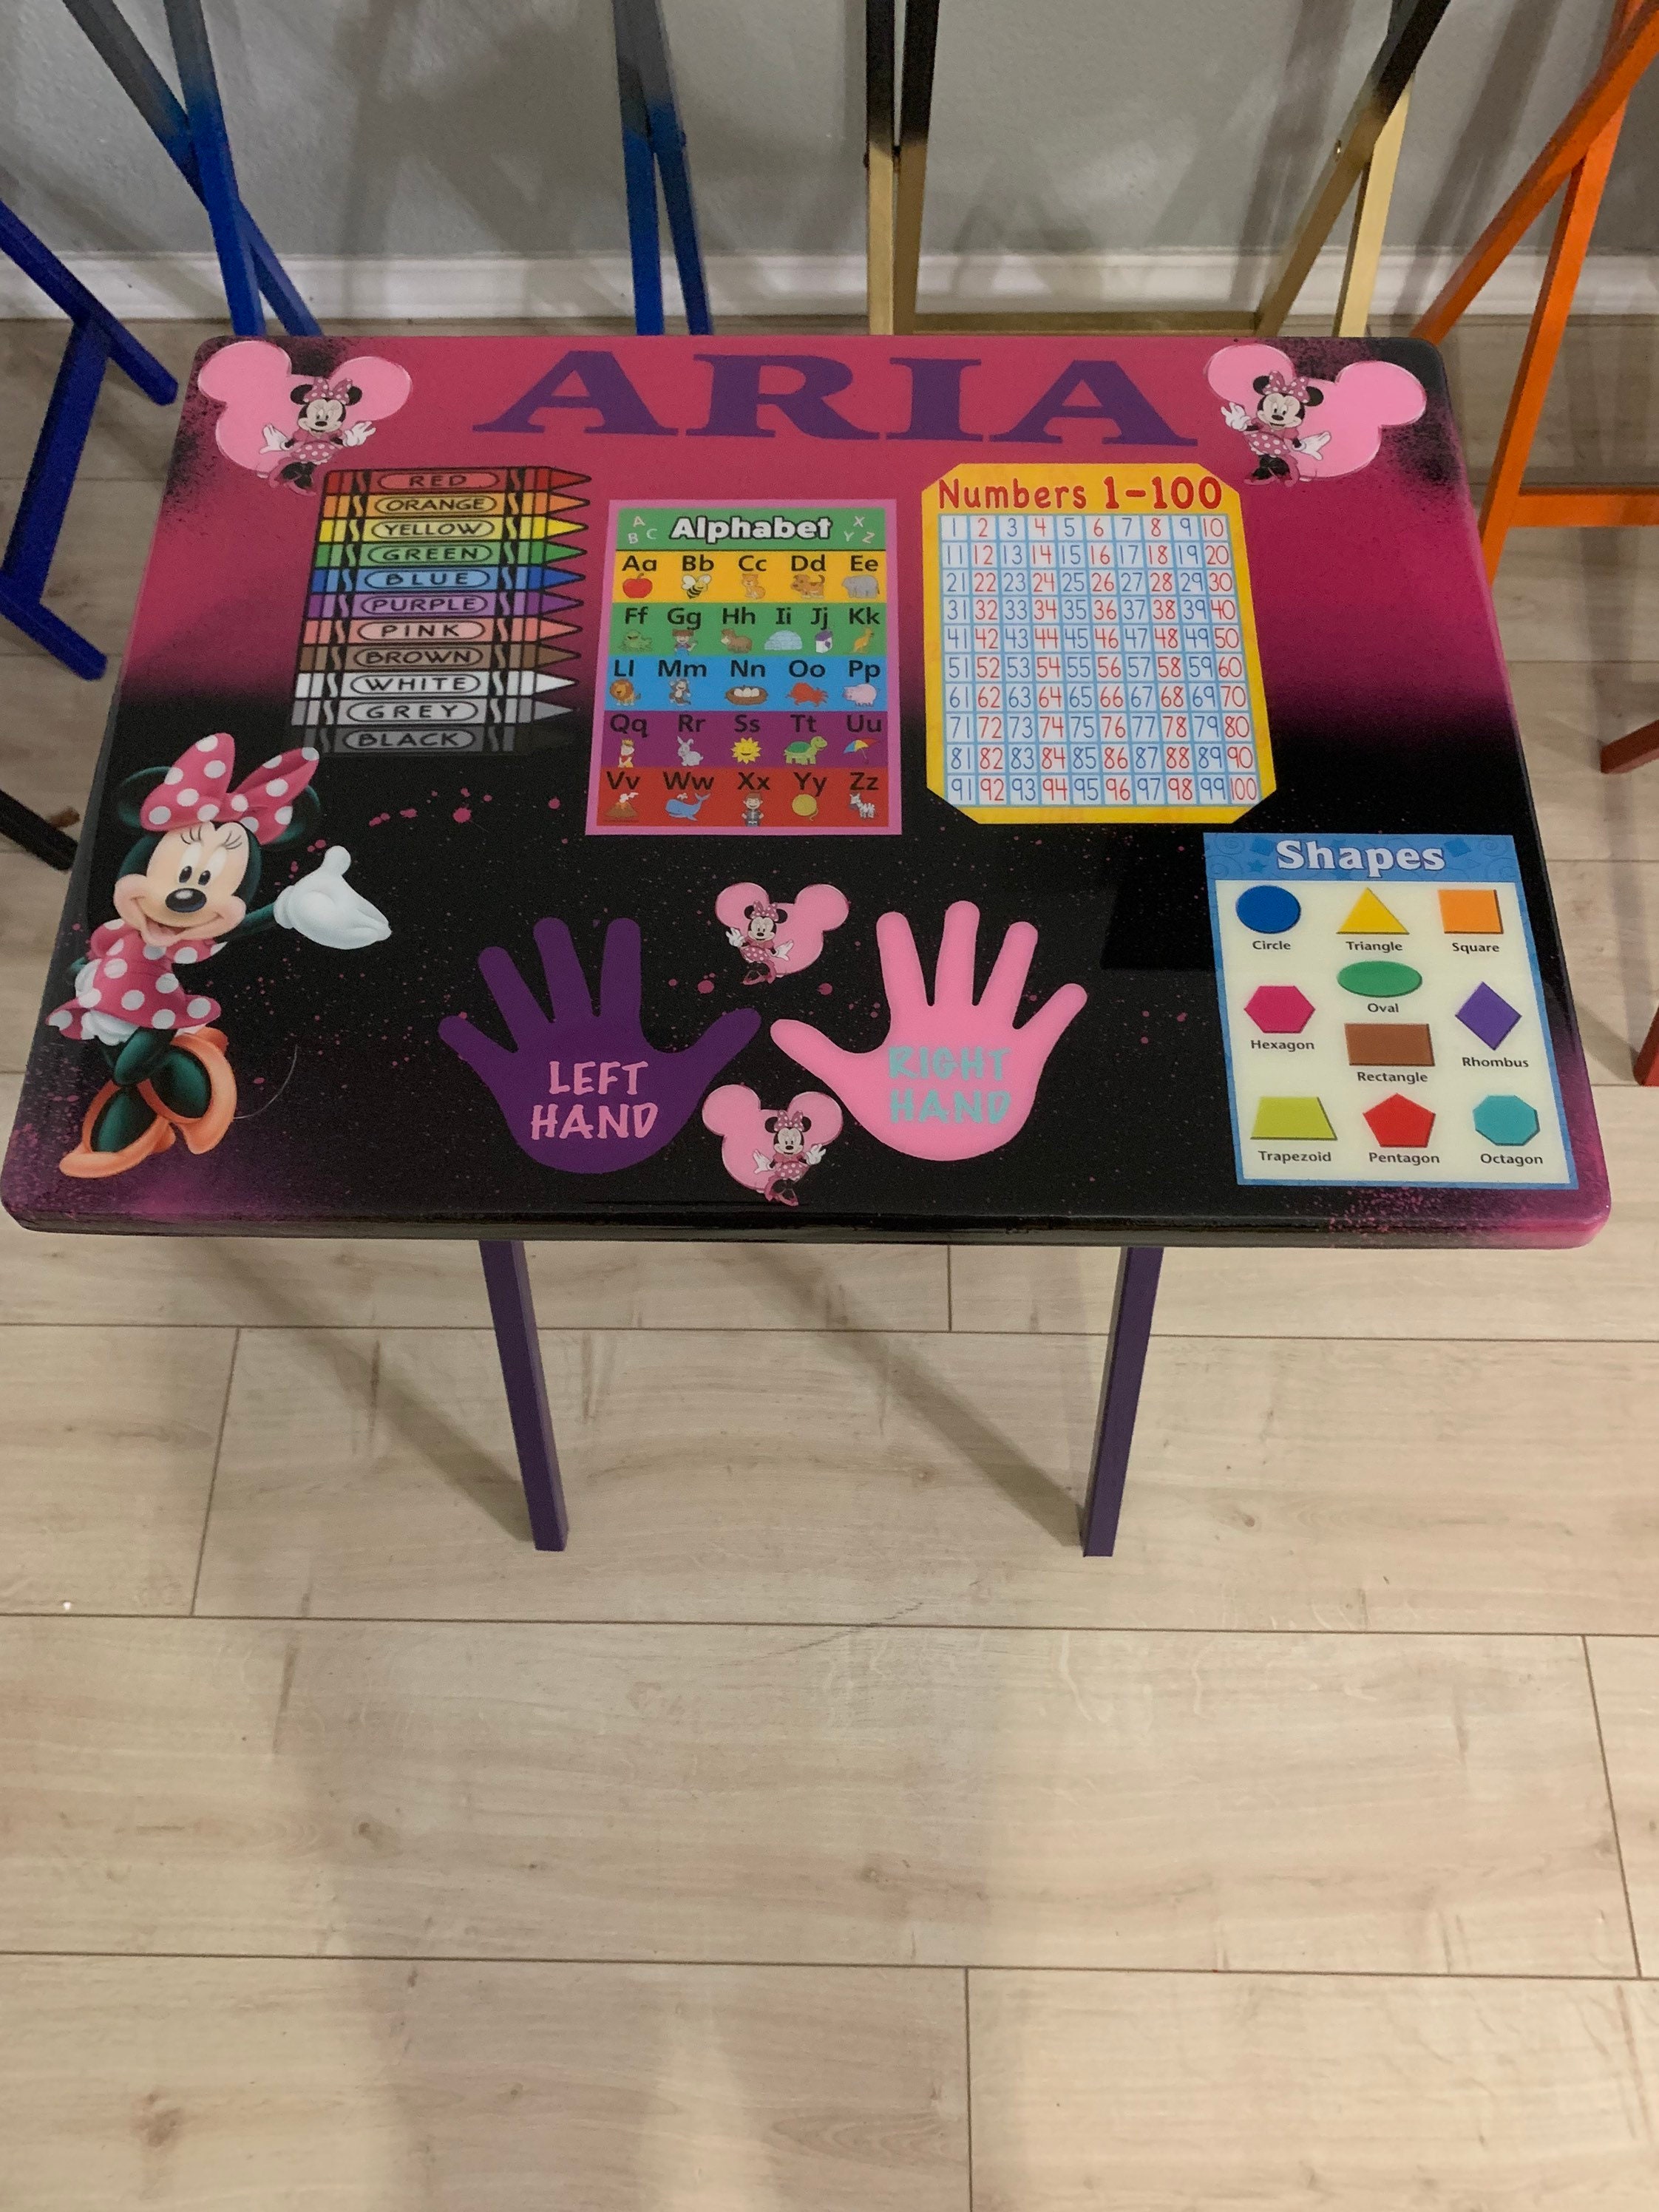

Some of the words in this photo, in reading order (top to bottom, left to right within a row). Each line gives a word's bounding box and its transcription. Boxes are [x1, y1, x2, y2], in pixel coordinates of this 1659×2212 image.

[472, 349, 1198, 447] ARIA
[409, 475, 467, 486] RED
[938, 478, 1087, 510] Numbers
[1104, 475, 1222, 510] 1-100
[386, 498, 484, 512] ORANGE
[385, 523, 481, 537] YELLOW
[669, 515, 832, 545] Alphabet
[1034, 517, 1046, 537] 4
[1093, 517, 1104, 537] 6
[1150, 517, 1161, 537] 8
[1202, 517, 1224, 537] 10
[383, 547, 478, 560] GREEN
[622, 554, 657, 571] Aa
[682, 554, 714, 571] Bb
[738, 554, 767, 571] Cc
[790, 554, 827, 572] Dd
[850, 554, 879, 572] Ee
[947, 545, 963, 565] 11
[974, 544, 993, 565] 12
[1003, 544, 1022, 565] 13
[1032, 544, 1052, 564] 14
[1062, 544, 1081, 565] 15
[1090, 545, 1110, 565] 16
[1119, 544, 1139, 564] 17
[1148, 544, 1168, 565] 18
[1178, 544, 1198, 564] 19
[1204, 544, 1229, 565] 20
[386, 572, 469, 586] BLUE
[946, 572, 966, 592] 21
[974, 571, 997, 592] 22
[1003, 572, 1026, 592] 23
[1032, 572, 1055, 593] 24
[1062, 571, 1085, 592] 25
[1091, 572, 1115, 592] 26
[1120, 571, 1143, 592] 27
[1149, 571, 1173, 592] 28
[1181, 571, 1204, 592] 29
[1209, 571, 1233, 592] 30
[371, 597, 476, 611] PURPLE
[947, 599, 966, 620] 31
[974, 599, 998, 620] 32
[1005, 599, 1028, 620] 33
[1034, 599, 1057, 620] 34
[1063, 598, 1087, 620] 35
[1093, 599, 1117, 620] 36
[1123, 598, 1146, 620] 37
[1153, 599, 1175, 620] 38
[1183, 598, 1207, 620] 39
[1210, 599, 1236, 620] 40
[624, 606, 648, 625] Ff
[667, 607, 702, 630] Gg
[722, 606, 756, 625] Hh
[776, 607, 793, 625] Ii
[810, 607, 829, 629] Jj
[849, 606, 880, 625] Kk
[381, 624, 459, 637] PINK
[947, 628, 967, 649] 41
[974, 628, 998, 649] 42
[1005, 628, 1029, 649] 43
[1034, 628, 1059, 649] 44
[1064, 628, 1088, 649] 45
[1094, 628, 1119, 649] 46
[1124, 627, 1148, 648] 47
[1154, 627, 1178, 648] 48
[1184, 627, 1210, 648] 49
[1214, 627, 1240, 649] 50
[366, 651, 471, 665] BROWN
[949, 656, 968, 679] 51
[976, 656, 1000, 679] 52
[1006, 656, 1031, 678] 53
[1036, 656, 1061, 678] 54
[1067, 656, 1090, 678] 55
[1097, 656, 1122, 678] 56
[1127, 656, 1151, 678] 57
[1157, 656, 1181, 678] 58
[1188, 655, 1213, 678] 59
[1218, 656, 1243, 678] 60
[613, 659, 634, 676] Ll
[657, 659, 707, 677] Mm
[730, 659, 766, 677] Nn
[788, 659, 826, 678] Oo
[848, 659, 881, 682] Pp
[365, 676, 466, 691] WHITE
[949, 686, 968, 709] 61
[977, 685, 1000, 708] 62
[1008, 686, 1031, 708] 63
[1038, 686, 1062, 708] 64
[1068, 685, 1093, 708] 65
[1099, 685, 1124, 708] 66
[1130, 685, 1153, 708] 67
[1160, 685, 1184, 708] 68
[1192, 685, 1215, 708] 69
[1220, 685, 1246, 708] 70
[366, 705, 458, 719] GREY
[609, 714, 648, 738] Qq
[678, 714, 706, 732] Rr
[733, 714, 761, 733] Ss
[790, 714, 817, 733] Tt
[846, 714, 882, 733] Uu
[949, 716, 970, 739] 71
[977, 716, 1002, 739] 72
[1008, 716, 1034, 739] 73
[1039, 716, 1064, 738] 74
[1070, 716, 1094, 738] 75
[1101, 716, 1126, 739] 76
[1131, 715, 1156, 737] 77
[1162, 715, 1187, 738] 78
[1193, 715, 1219, 737] 79
[1224, 715, 1250, 738] 80
[358, 731, 457, 747] BLACK
[951, 746, 971, 770] 81
[980, 747, 1003, 770] 82
[1010, 746, 1034, 770] 83
[1041, 746, 1066, 770] 84
[1073, 746, 1096, 770] 85
[1104, 746, 1128, 770] 86
[1135, 745, 1158, 770] 87
[1166, 746, 1190, 769] 88
[1198, 746, 1222, 769] 89
[1227, 745, 1253, 769] 90
[605, 770, 640, 790] Vv
[662, 770, 714, 790] Ww
[737, 771, 770, 790] Xx
[793, 772, 827, 797] Yy
[849, 772, 879, 790] Zz
[951, 778, 971, 801] 91
[980, 777, 1004, 801] 92
[1011, 777, 1037, 801] 93
[1042, 778, 1068, 801] 94
[1073, 777, 1099, 801] 95
[1105, 777, 1130, 801] 96
[1136, 777, 1161, 801] 97
[1167, 777, 1192, 801] 98
[1200, 777, 1226, 800] 99
[1230, 777, 1257, 801] 100
[1275, 839, 1446, 878] Shapes
[1252, 940, 1291, 951] Circle
[1346, 941, 1403, 953] Triangle
[1452, 942, 1500, 954] Square
[1367, 1002, 1400, 1014] Oval
[1251, 1039, 1315, 1052] Hexagon
[888, 1045, 1013, 1082] RIGHT
[1462, 1056, 1529, 1068] Rhombus
[548, 1059, 649, 1096] LEFT
[1357, 1071, 1428, 1085] Rectangle
[889, 1088, 1013, 1125] HAND
[530, 1101, 659, 1141] HAND
[1258, 1150, 1332, 1164] Trapezoid
[1368, 1152, 1440, 1165] Pentagon
[1480, 1153, 1544, 1167] Octagon
